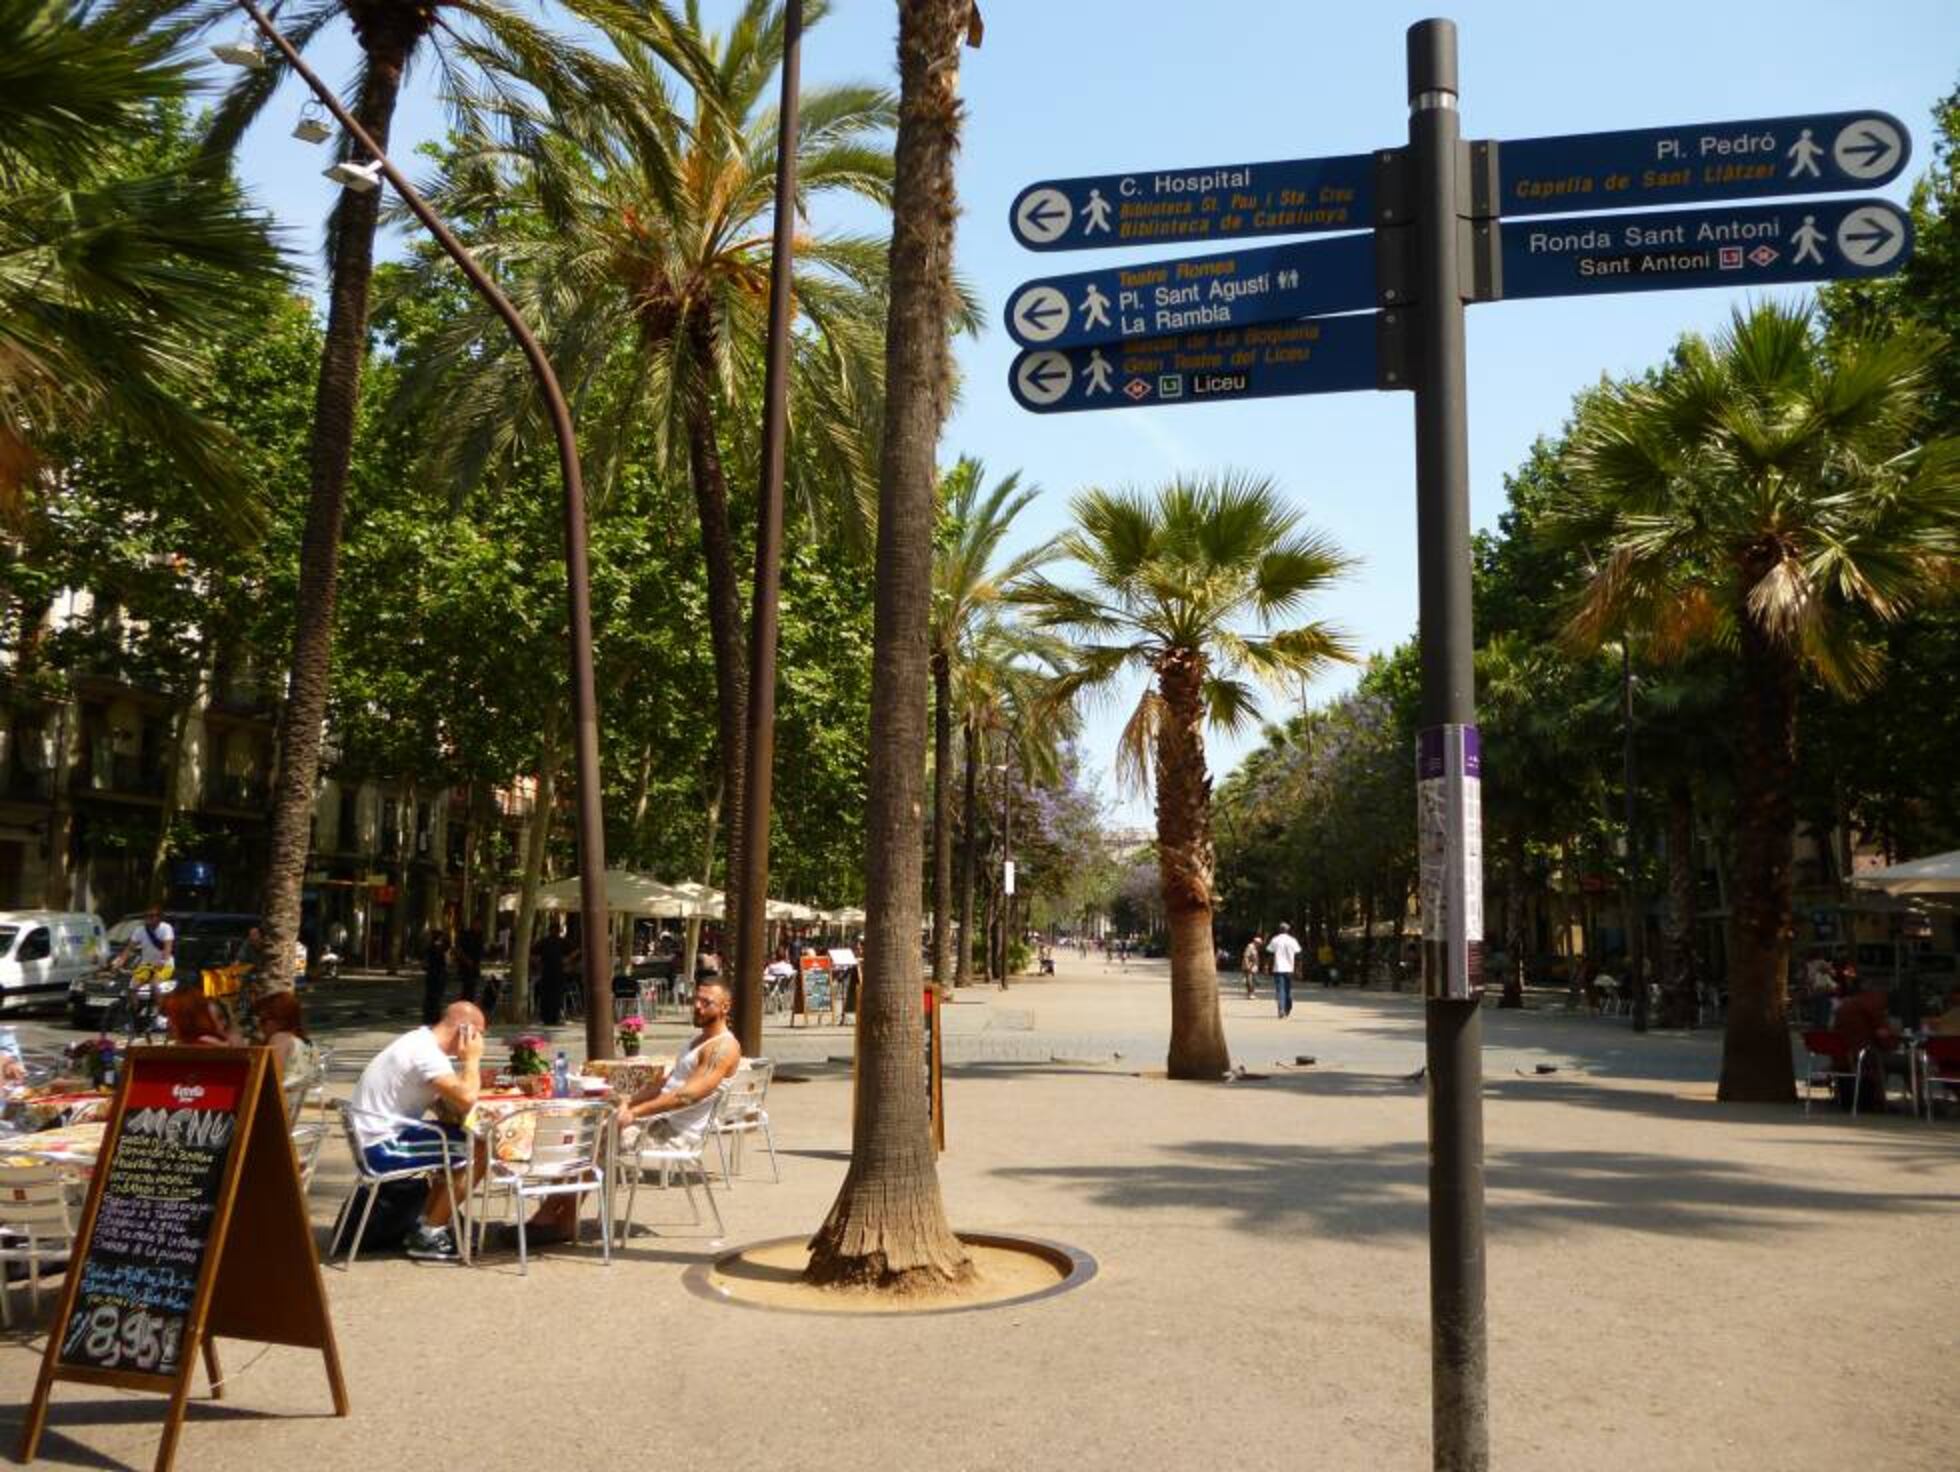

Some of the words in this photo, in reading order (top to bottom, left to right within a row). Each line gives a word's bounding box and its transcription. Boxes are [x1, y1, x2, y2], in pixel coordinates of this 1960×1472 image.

[1657, 138, 1688, 160] Pl.
[1700, 131, 1776, 157] Pedró
[1119, 177, 1143, 197] C.
[1154, 169, 1249, 194] Hospital
[1605, 173, 1632, 193] de
[1643, 167, 1691, 189] Sant
[1220, 215, 1243, 232] de
[1254, 208, 1347, 228] Catalunya
[1529, 230, 1612, 254] Ronda
[1624, 225, 1685, 247] Sant
[1697, 218, 1781, 241] Antoni
[1579, 257, 1630, 277] Sant
[1640, 251, 1712, 273] Antoni
[1119, 290, 1145, 312] Pl.
[1155, 283, 1200, 308] Sant
[1120, 315, 1146, 335] La
[1156, 305, 1231, 330] Rambla
[1194, 373, 1246, 395] Liceu
